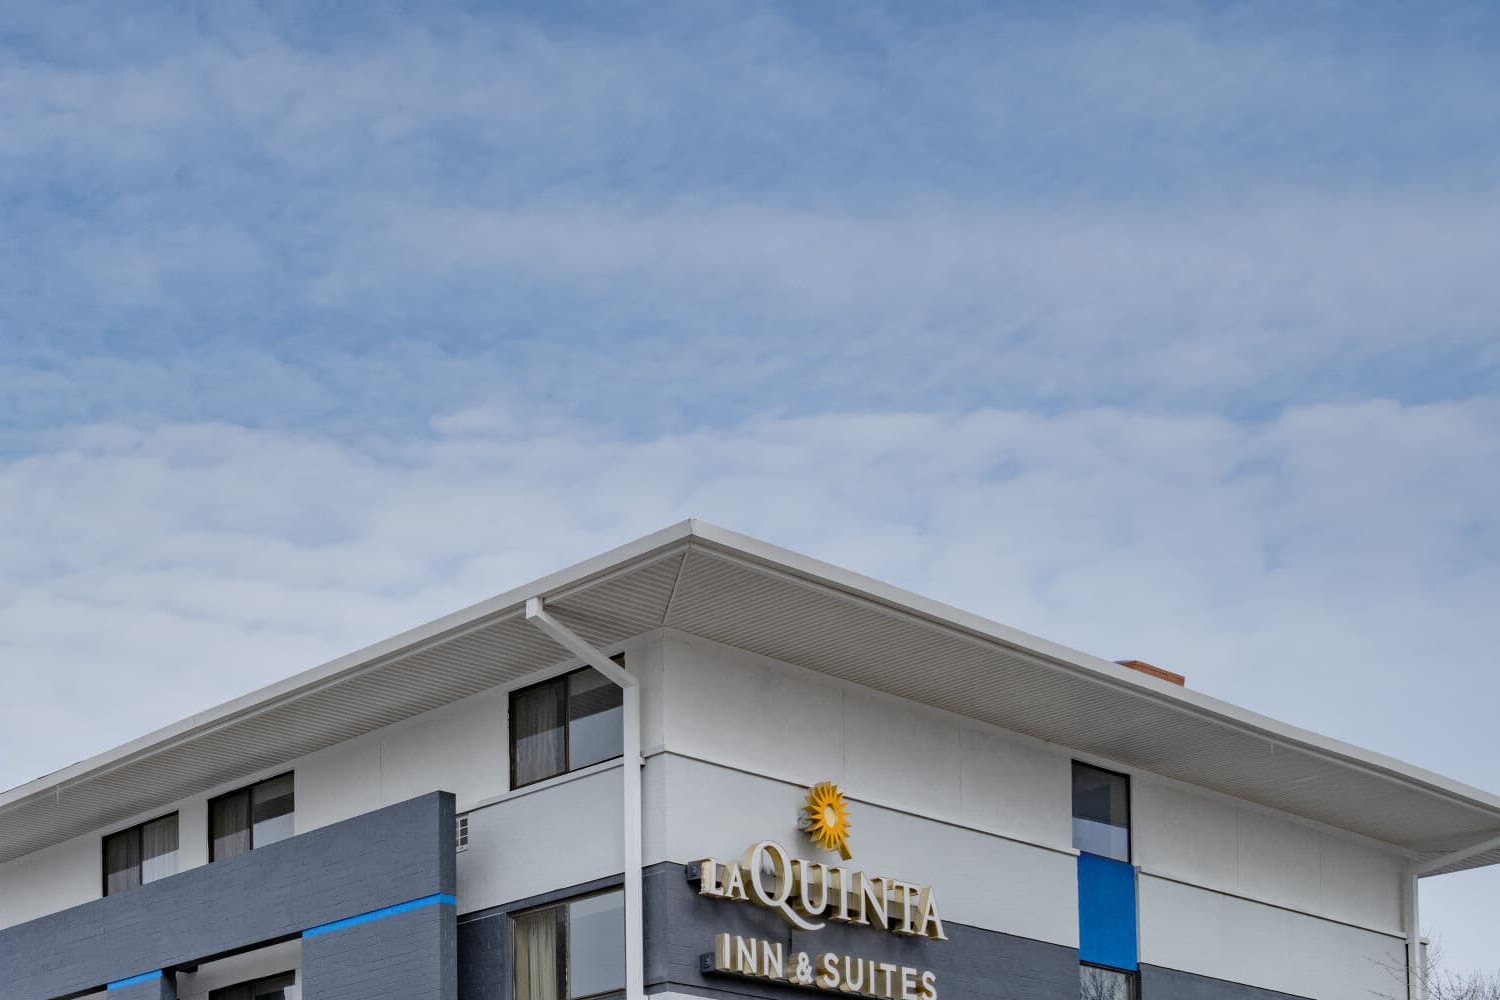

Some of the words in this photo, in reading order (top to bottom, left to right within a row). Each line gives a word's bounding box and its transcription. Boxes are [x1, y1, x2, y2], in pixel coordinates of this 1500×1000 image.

[699, 857, 750, 900] LA
[747, 840, 948, 940] QUINTA
[718, 933, 783, 979] INN
[792, 952, 813, 985] &
